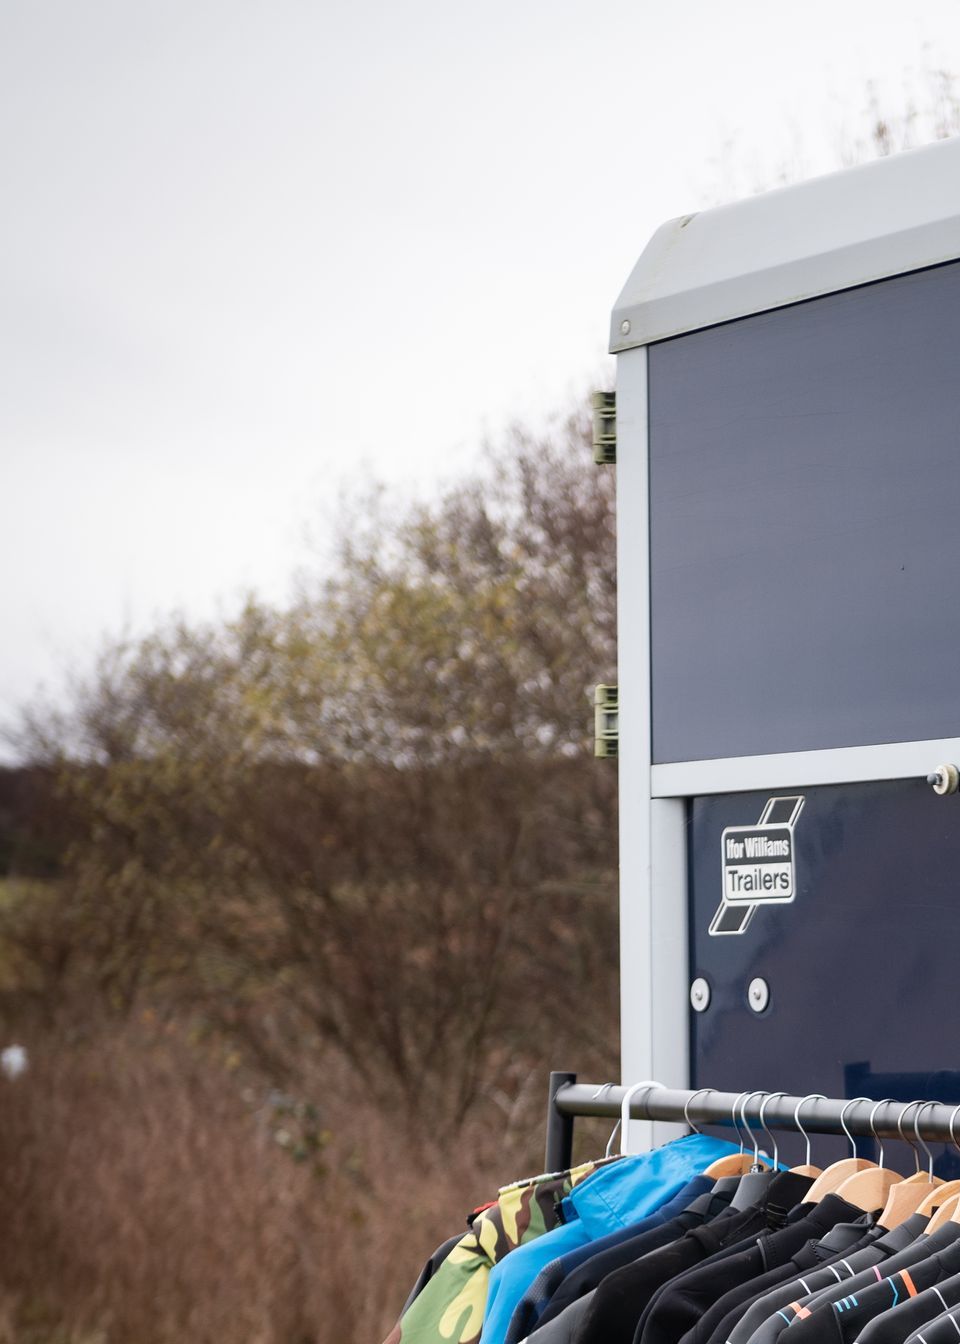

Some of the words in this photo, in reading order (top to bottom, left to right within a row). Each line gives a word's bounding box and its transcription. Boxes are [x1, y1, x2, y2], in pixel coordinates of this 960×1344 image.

[727, 838, 744, 859] Ifor
[745, 836, 789, 857] Williams
[728, 868, 789, 892] Trailers
